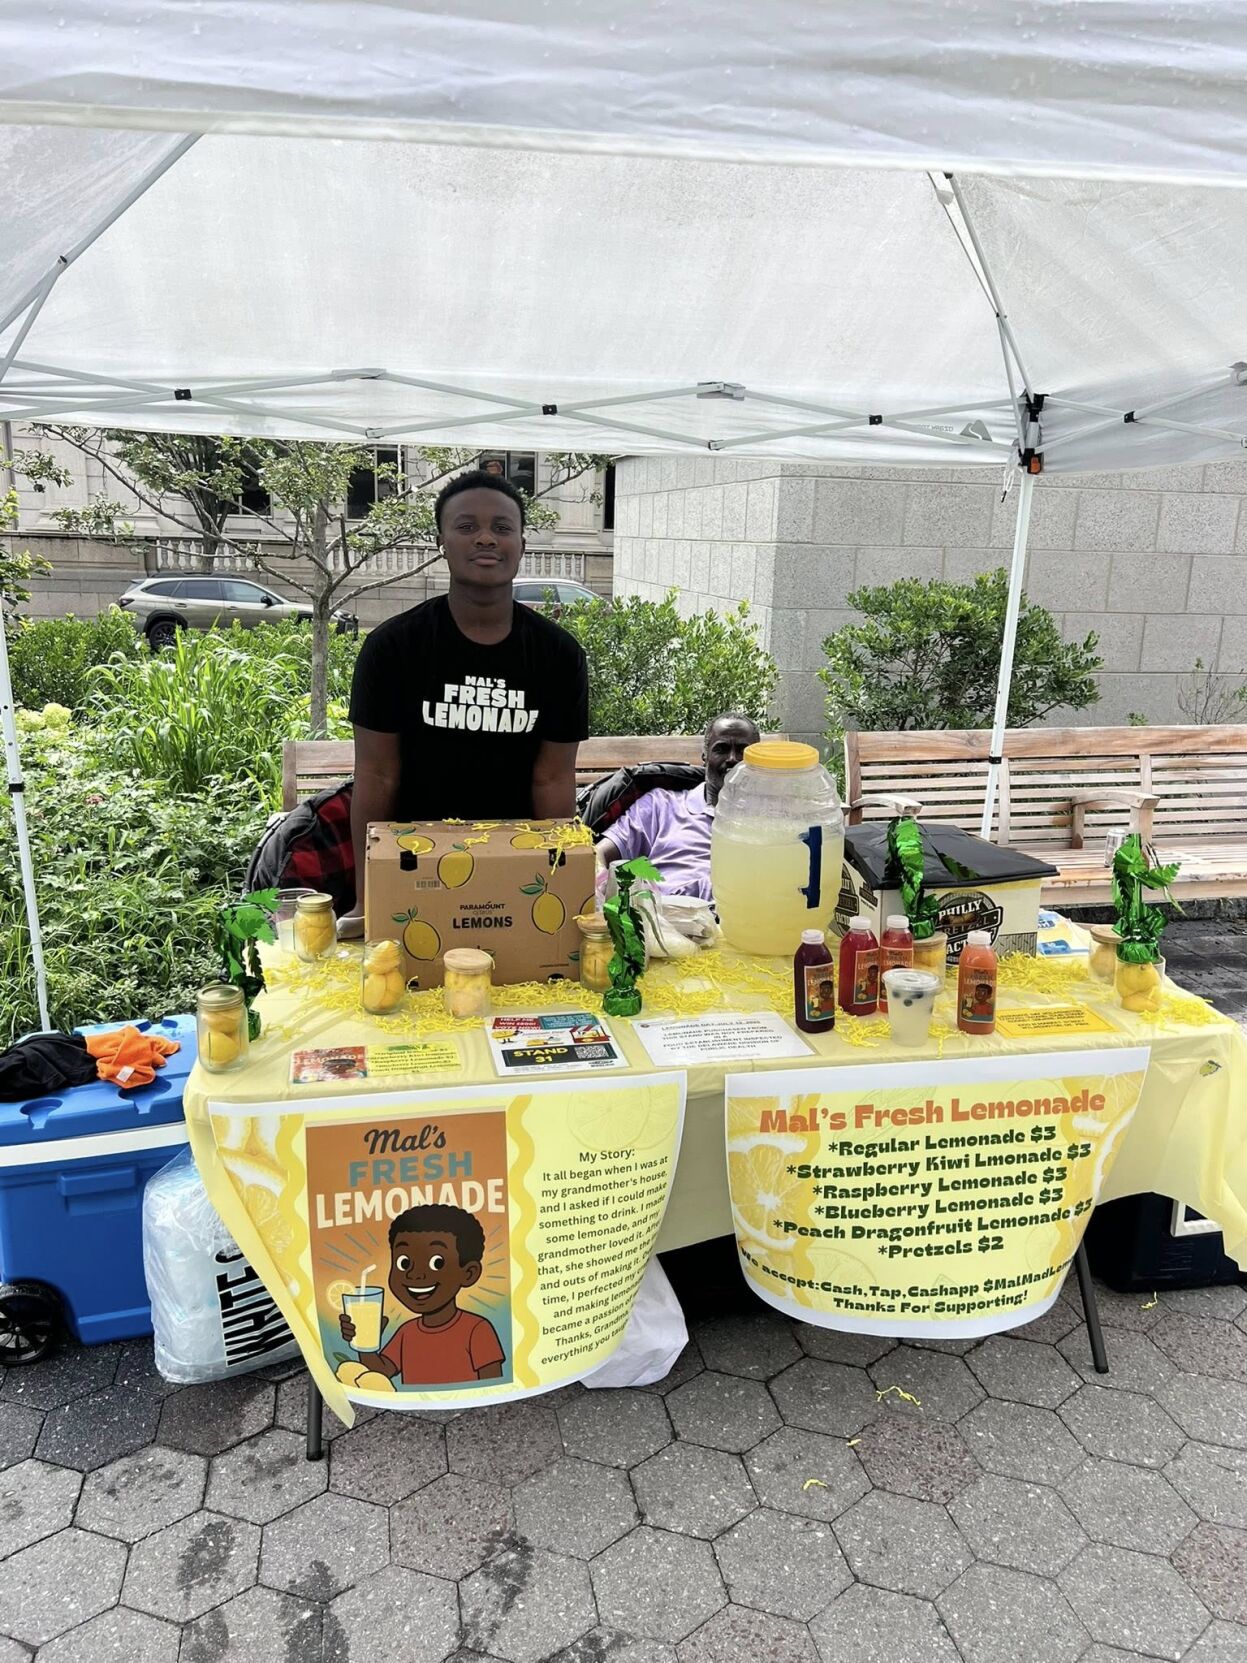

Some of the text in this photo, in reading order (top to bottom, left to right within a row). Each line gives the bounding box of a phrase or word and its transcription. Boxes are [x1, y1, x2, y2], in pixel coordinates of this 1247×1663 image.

[465, 675, 506, 688] MAL'S
[443, 683, 525, 709] FRESH
[422, 700, 539, 733] LEMONADE
[452, 915, 513, 929] LEMONS
[938, 899, 982, 921] PHILLY
[944, 916, 989, 936] RETZEL
[513, 1047, 569, 1057] STAND
[759, 1089, 1106, 1133] Mal's Fresh Lemonade
[364, 1124, 447, 1155] Mal's
[925, 1129, 1026, 1150] Lemonade
[1030, 1125, 1057, 1143] $3
[348, 1151, 473, 1187] FRESH
[543, 1171, 551, 1181] It
[553, 1170, 567, 1181] all
[569, 1168, 602, 1180] began
[604, 1163, 632, 1176] when
[640, 1160, 658, 1170] was
[659, 1156, 668, 1165] at
[579, 1148, 635, 1164] My Story:
[926, 1153, 970, 1171] Kiwi
[974, 1147, 1063, 1168] Lmonade
[1066, 1143, 1092, 1161] $3
[541, 1187, 558, 1199] my
[560, 1178, 638, 1199] grandmother's
[938, 1170, 1038, 1192] Lemonade
[1042, 1166, 1068, 1185] $3
[316, 1179, 506, 1229] LEMONADE
[539, 1203, 560, 1214] and
[569, 1198, 600, 1210] asked
[602, 1196, 611, 1206] if
[617, 1189, 645, 1203] could
[646, 1182, 667, 1196] make
[935, 1192, 1035, 1214] Lemonade
[1038, 1187, 1064, 1205] $3
[538, 1213, 596, 1230] something
[598, 1213, 609, 1222] to
[611, 1206, 639, 1219] drink.
[546, 1233, 575, 1244] some
[577, 1222, 630, 1240] lemonade,
[631, 1216, 648, 1228] and
[851, 1218, 973, 1242] Dragonfruit
[977, 1207, 1072, 1231] Lemonade
[1074, 1197, 1093, 1217] $3
[537, 1242, 607, 1263] grandmother
[609, 1234, 635, 1249] loved
[636, 1231, 645, 1240] it.
[741, 1246, 759, 1268] We
[978, 1235, 1004, 1253] $2
[537, 1266, 563, 1276] that,
[565, 1261, 584, 1272] she
[586, 1252, 623, 1268] showed
[625, 1248, 638, 1258] me
[540, 1278, 560, 1290] and
[563, 1275, 586, 1287] outs
[588, 1271, 599, 1281] of
[600, 1262, 632, 1279] making
[542, 1294, 569, 1306] time,
[577, 1277, 623, 1300] perfected
[624, 1271, 636, 1283] my
[553, 1306, 573, 1319] and
[575, 1297, 610, 1314] making
[833, 1290, 1028, 1315] Thanks For Supporting!
[216, 1265, 297, 1367] WHITE
[542, 1320, 583, 1335] became
[592, 1303, 624, 1324] passion
[541, 1342, 594, 1365] everything
[595, 1334, 611, 1349] you
[555, 1331, 592, 1347] Thanks,
